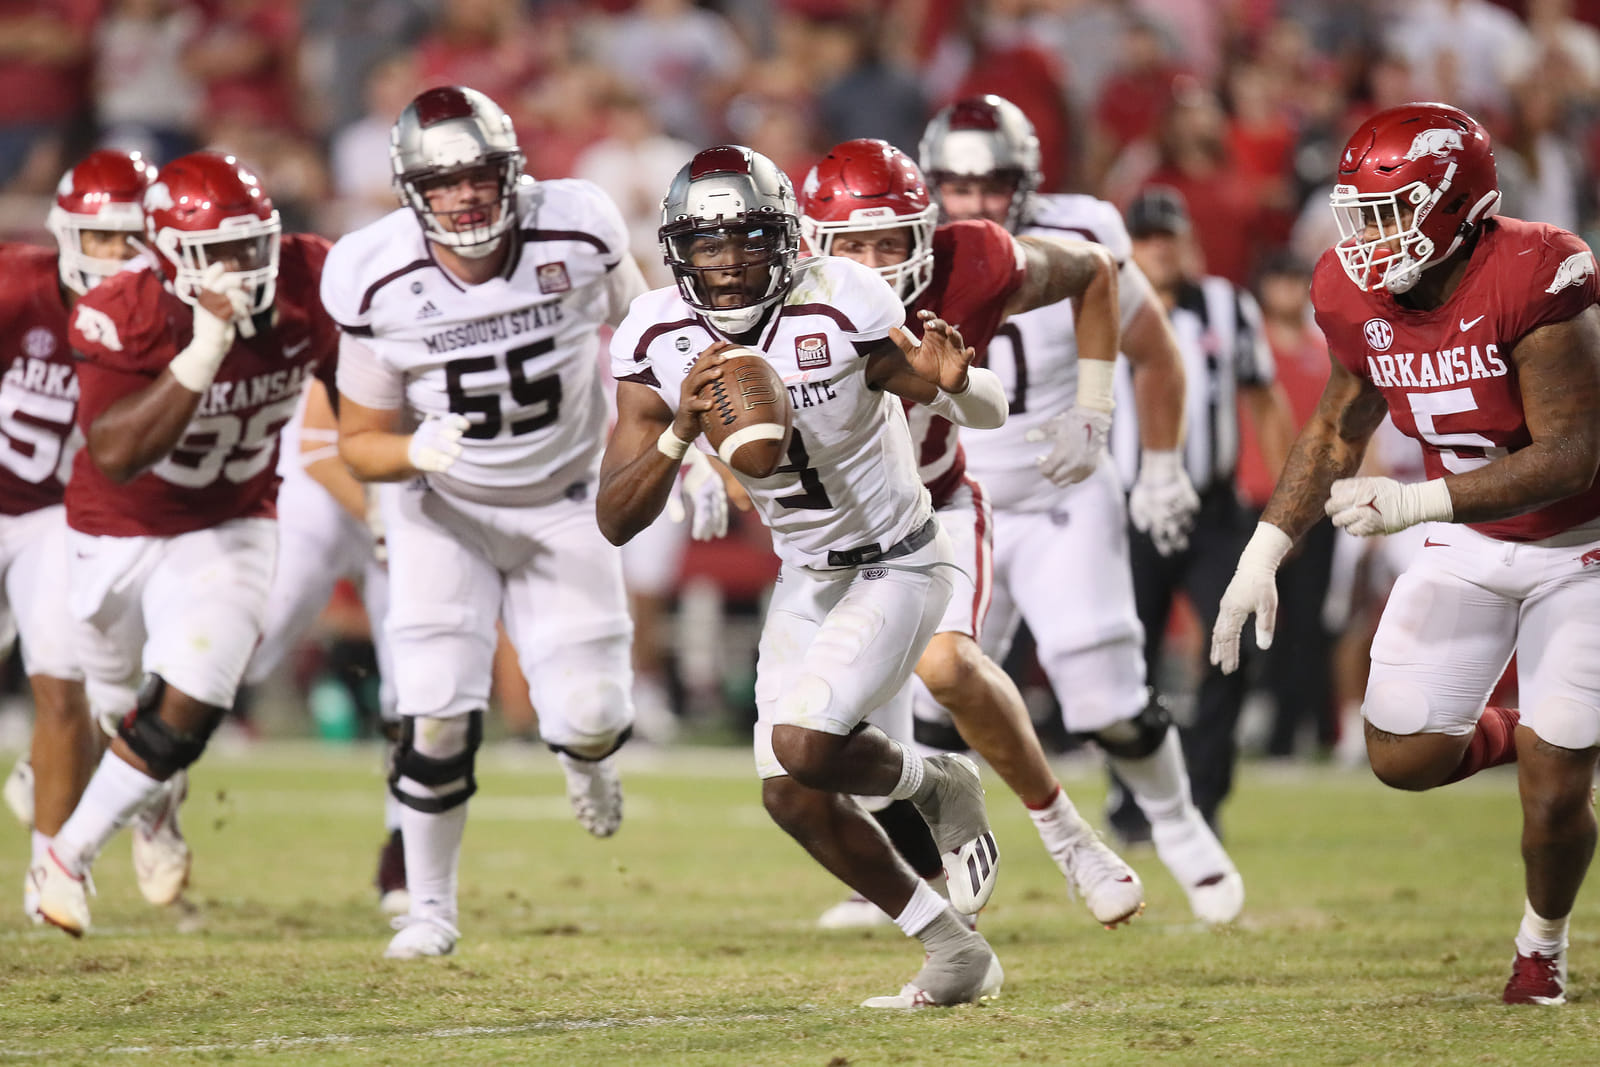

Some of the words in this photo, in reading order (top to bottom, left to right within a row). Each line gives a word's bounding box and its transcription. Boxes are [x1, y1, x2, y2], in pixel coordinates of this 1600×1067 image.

[422, 314, 509, 354] MISSOURI
[509, 299, 564, 335] STATE
[1365, 320, 1392, 349] SEC
[3, 356, 81, 401] ARKA
[445, 337, 562, 440] 55
[1367, 344, 1508, 388] ARKANSAS
[787, 378, 837, 410] TATE
[0, 382, 86, 485] 5
[1406, 387, 1509, 476] 5
